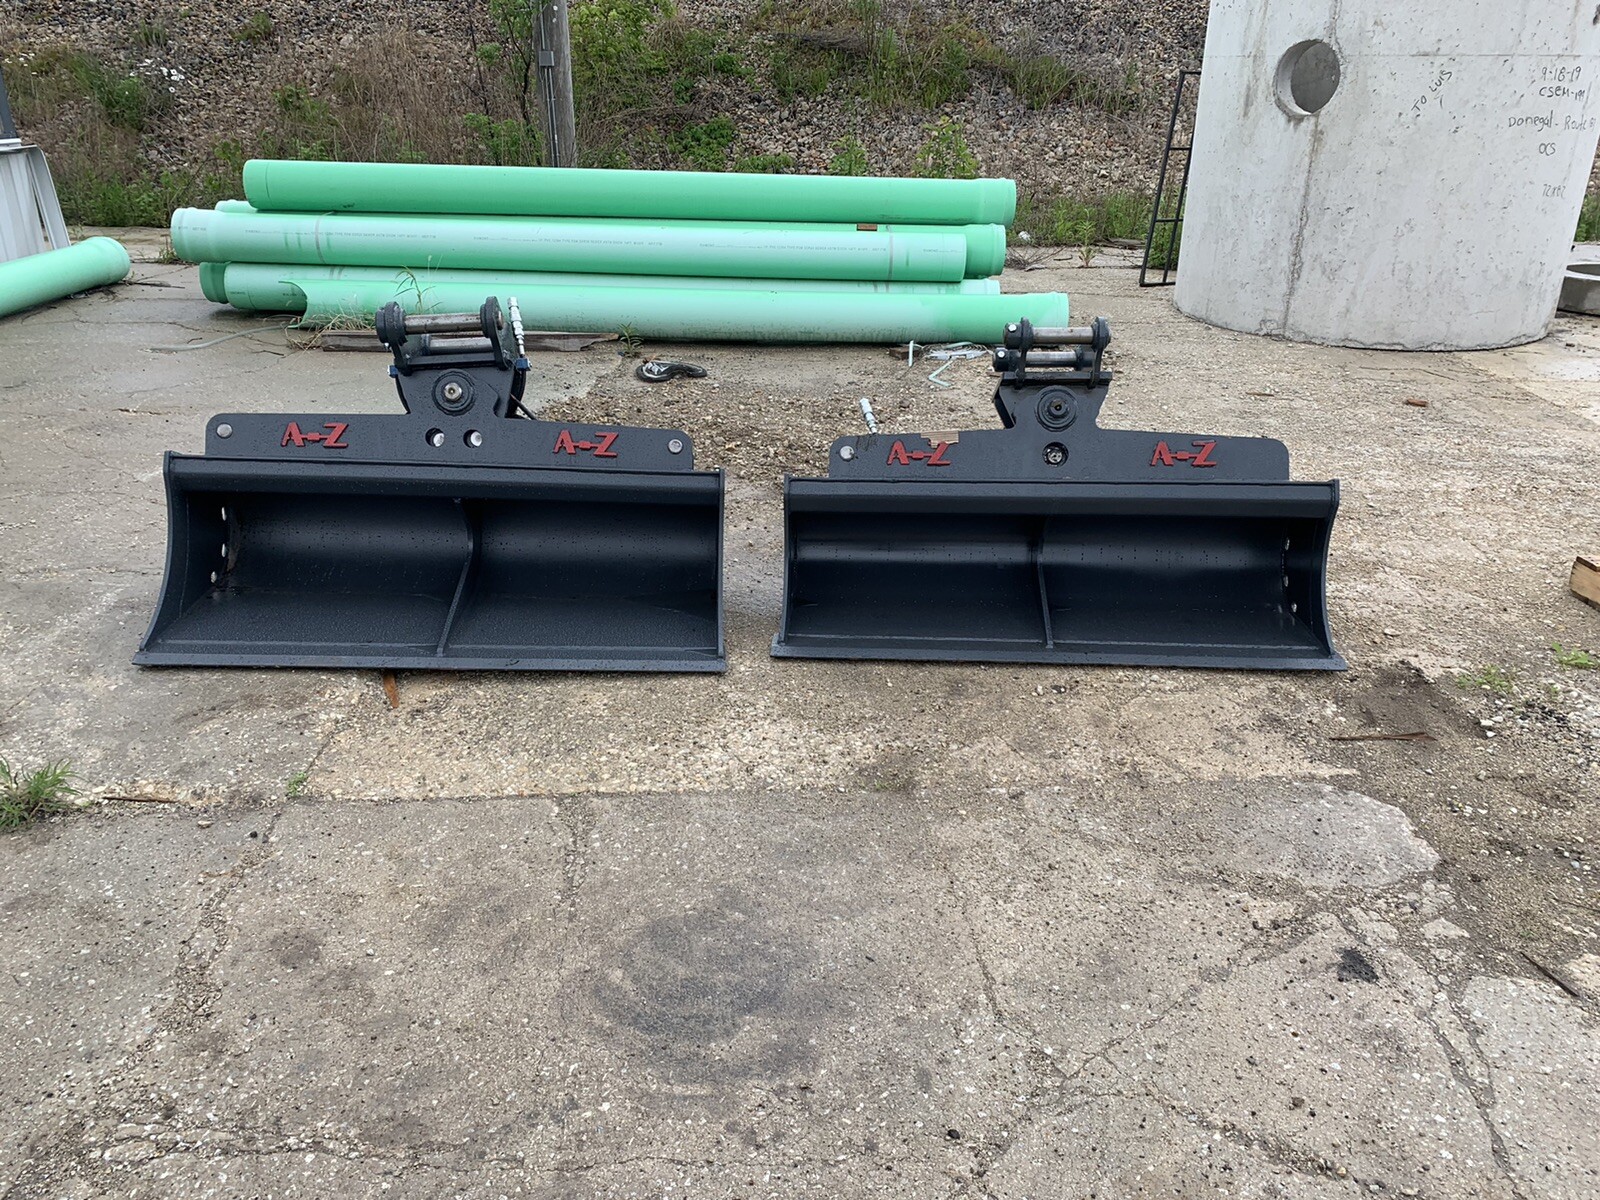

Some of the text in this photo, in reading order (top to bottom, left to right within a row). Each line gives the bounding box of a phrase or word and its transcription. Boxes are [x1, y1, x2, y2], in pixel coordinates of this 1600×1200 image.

[1411, 69, 1453, 111] TO LUIS
[281, 422, 349, 448] A-Z
[553, 429, 619, 458] A-Z
[1150, 440, 1217, 467] A-Z
